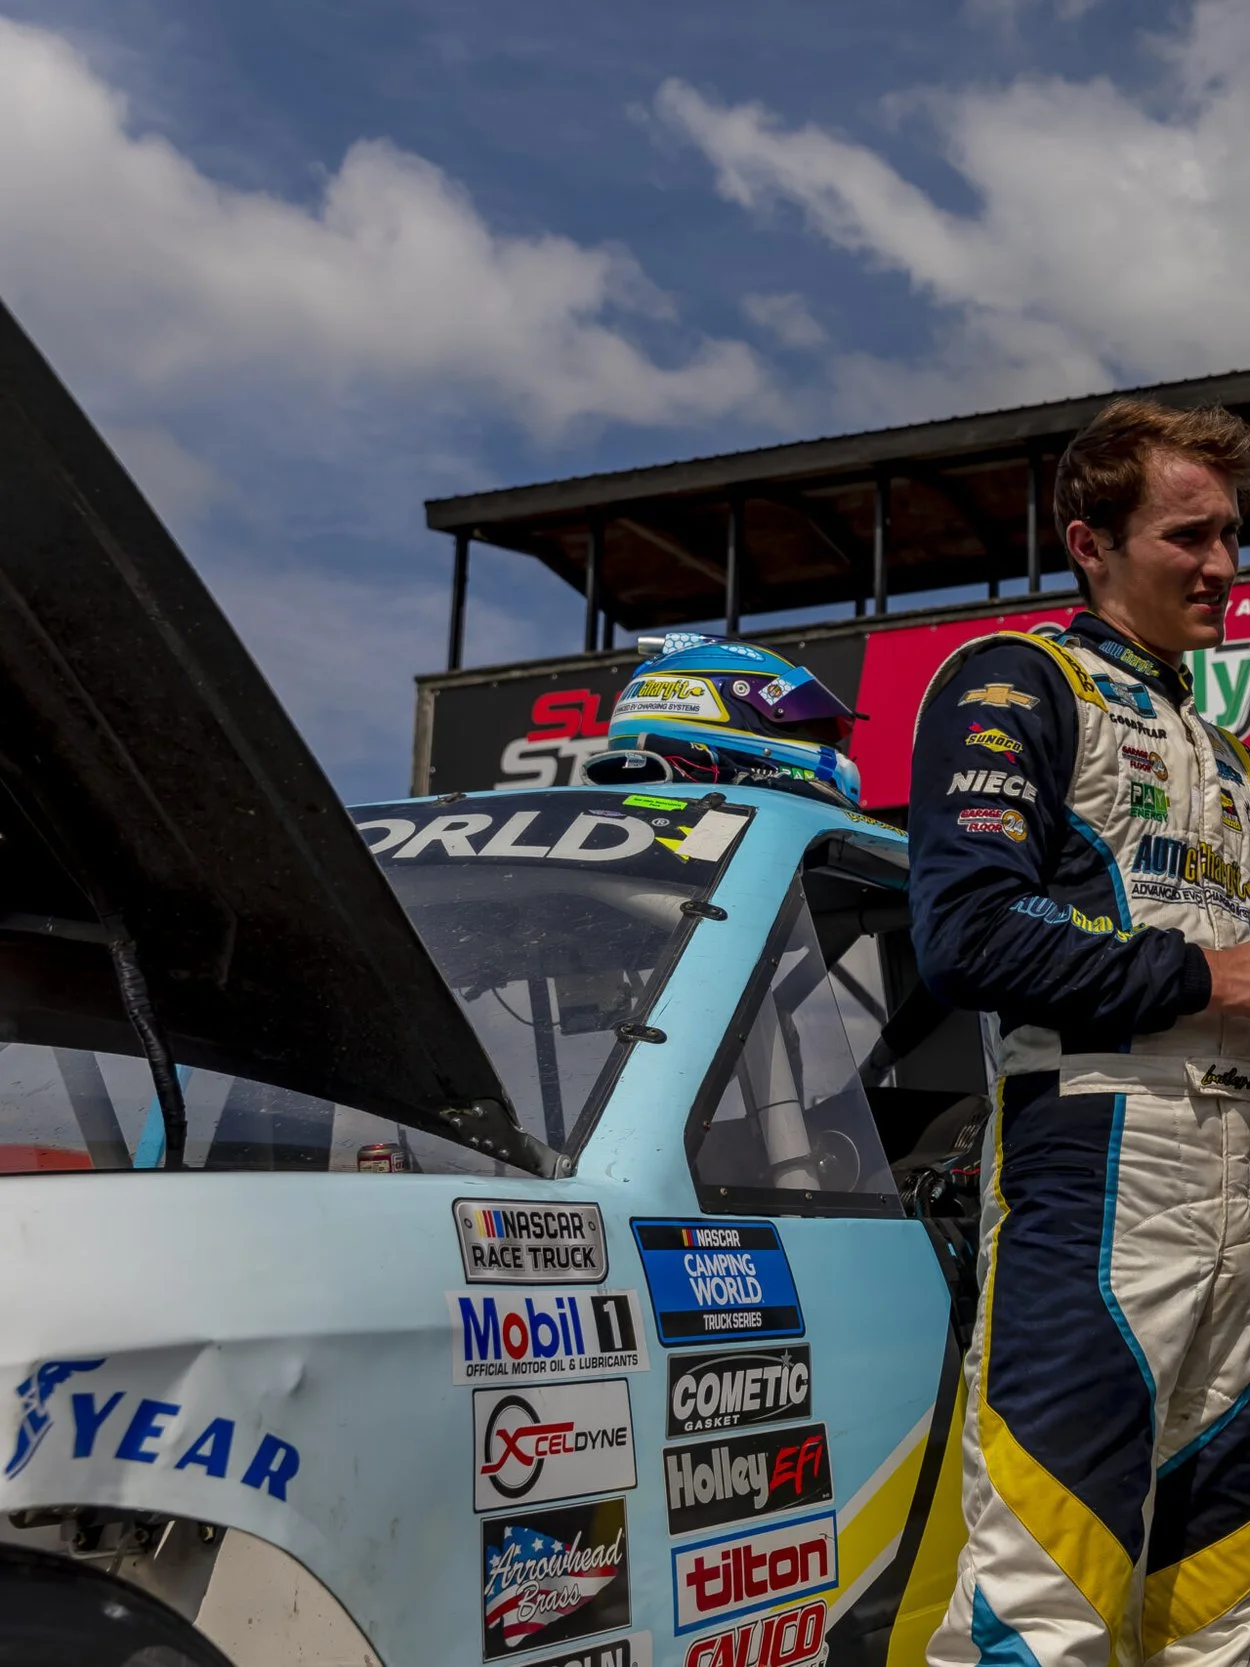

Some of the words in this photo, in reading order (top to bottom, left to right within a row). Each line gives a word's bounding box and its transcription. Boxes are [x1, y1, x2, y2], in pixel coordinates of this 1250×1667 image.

[668, 703, 701, 712] SYSTEMS
[968, 734, 1021, 752] SUNOCO
[946, 769, 1039, 803] NIECE
[1132, 783, 1166, 808] PAY
[960, 808, 1002, 818] GARAGE
[1005, 815, 1024, 835] 24
[968, 822, 1002, 832] FLOOR
[502, 1210, 586, 1239] NASCAR
[696, 1229, 741, 1247] NASCAR
[471, 1245, 523, 1269] RACE
[527, 1247, 597, 1269] TRUCK
[683, 1253, 757, 1277] CAMPING
[689, 1277, 762, 1306] WORLD
[458, 1297, 586, 1361] Mobil
[703, 1313, 732, 1330] TRUCK
[732, 1312, 762, 1328] SERIES
[466, 1362, 509, 1377] OFFICIAL
[511, 1360, 547, 1375] MOTOR
[550, 1359, 565, 1373] OIL
[569, 1358, 576, 1370] &
[579, 1354, 639, 1369] LUBRICANTS
[673, 1362, 809, 1420] COMETIC
[684, 1414, 740, 1432] GASKET
[480, 1422, 627, 1475] XCELDYNE
[666, 1446, 770, 1510] Holley
[769, 1435, 823, 1496] EFI
[484, 1527, 624, 1595] Arrowhead
[686, 1538, 828, 1612] tilton
[516, 1580, 582, 1622] Brass
